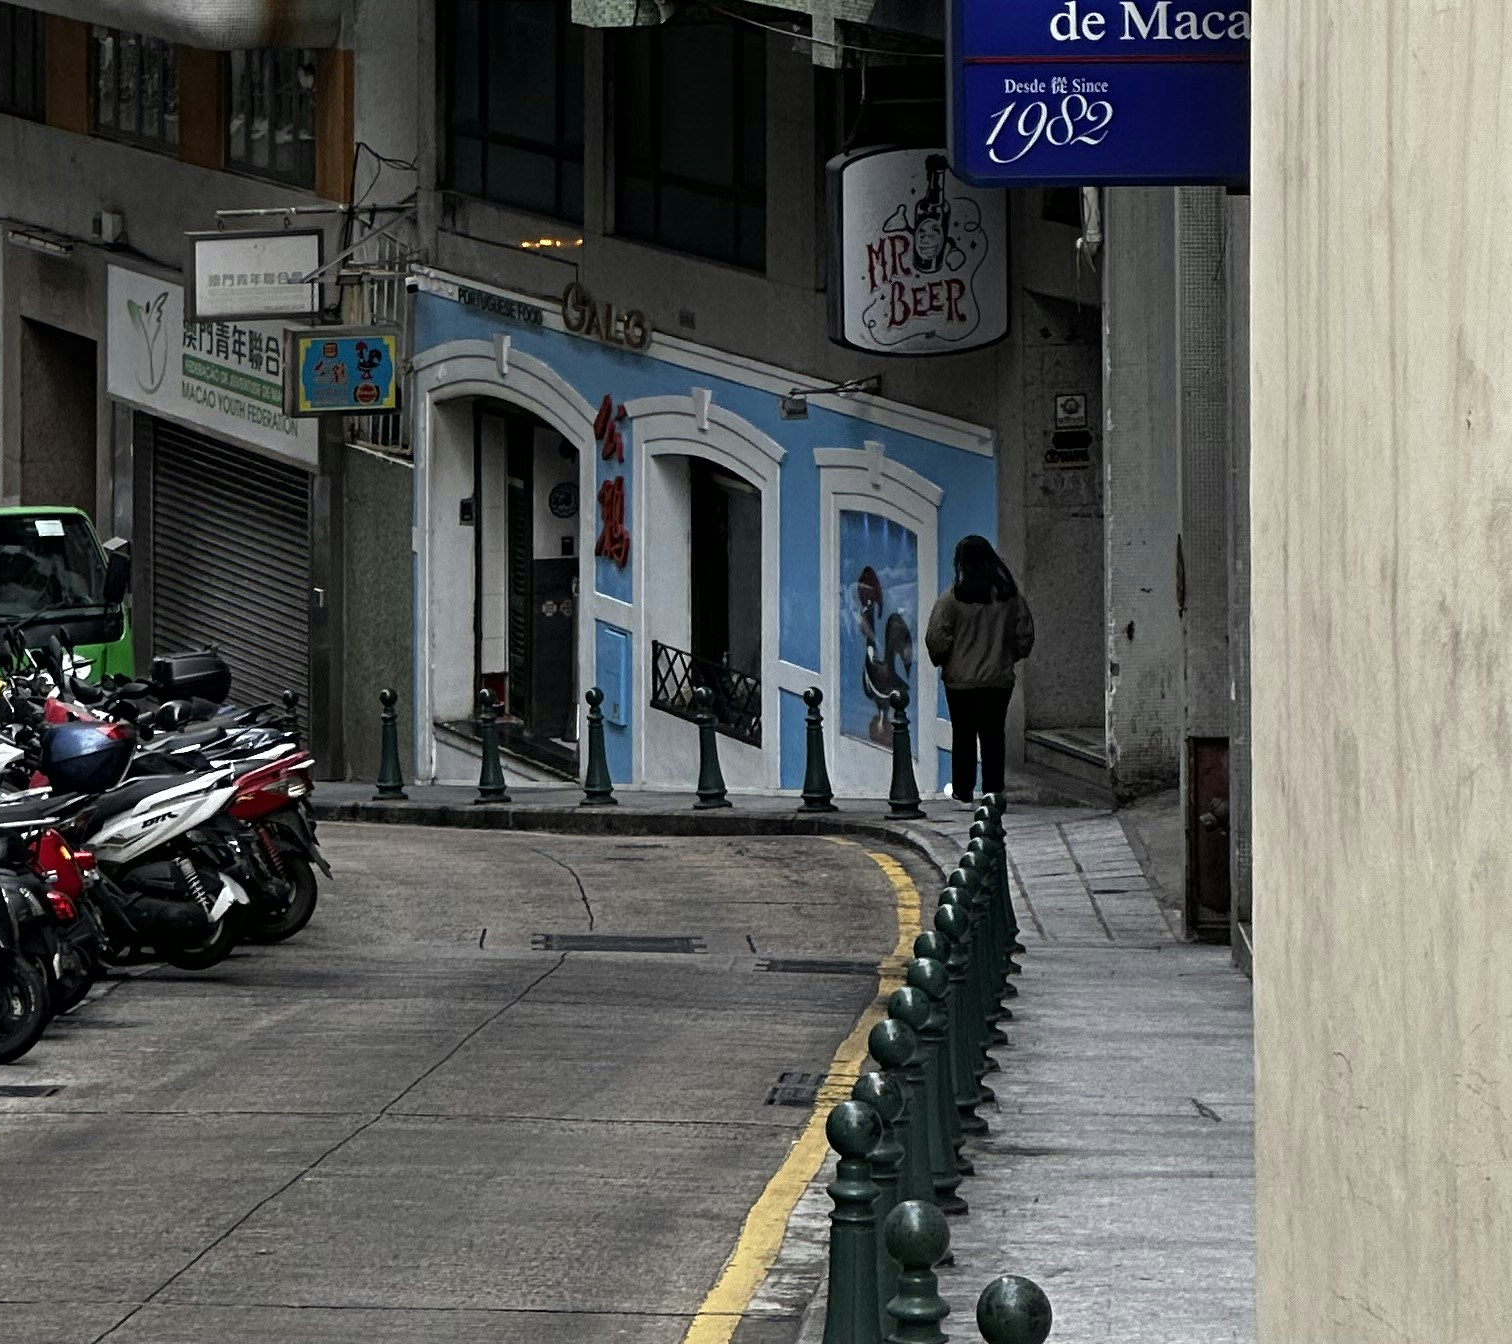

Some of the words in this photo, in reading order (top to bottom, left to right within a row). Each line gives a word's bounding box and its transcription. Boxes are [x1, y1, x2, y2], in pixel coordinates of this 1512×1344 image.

[1049, 0, 1106, 41] de
[1004, 78, 1046, 94] Desde
[1072, 78, 1109, 94] Since
[986, 93, 1114, 164] 1982
[866, 235, 912, 293] MR
[887, 278, 967, 330] BEER
[182, 380, 217, 409] MACAO
[217, 394, 247, 419] YOUTH
